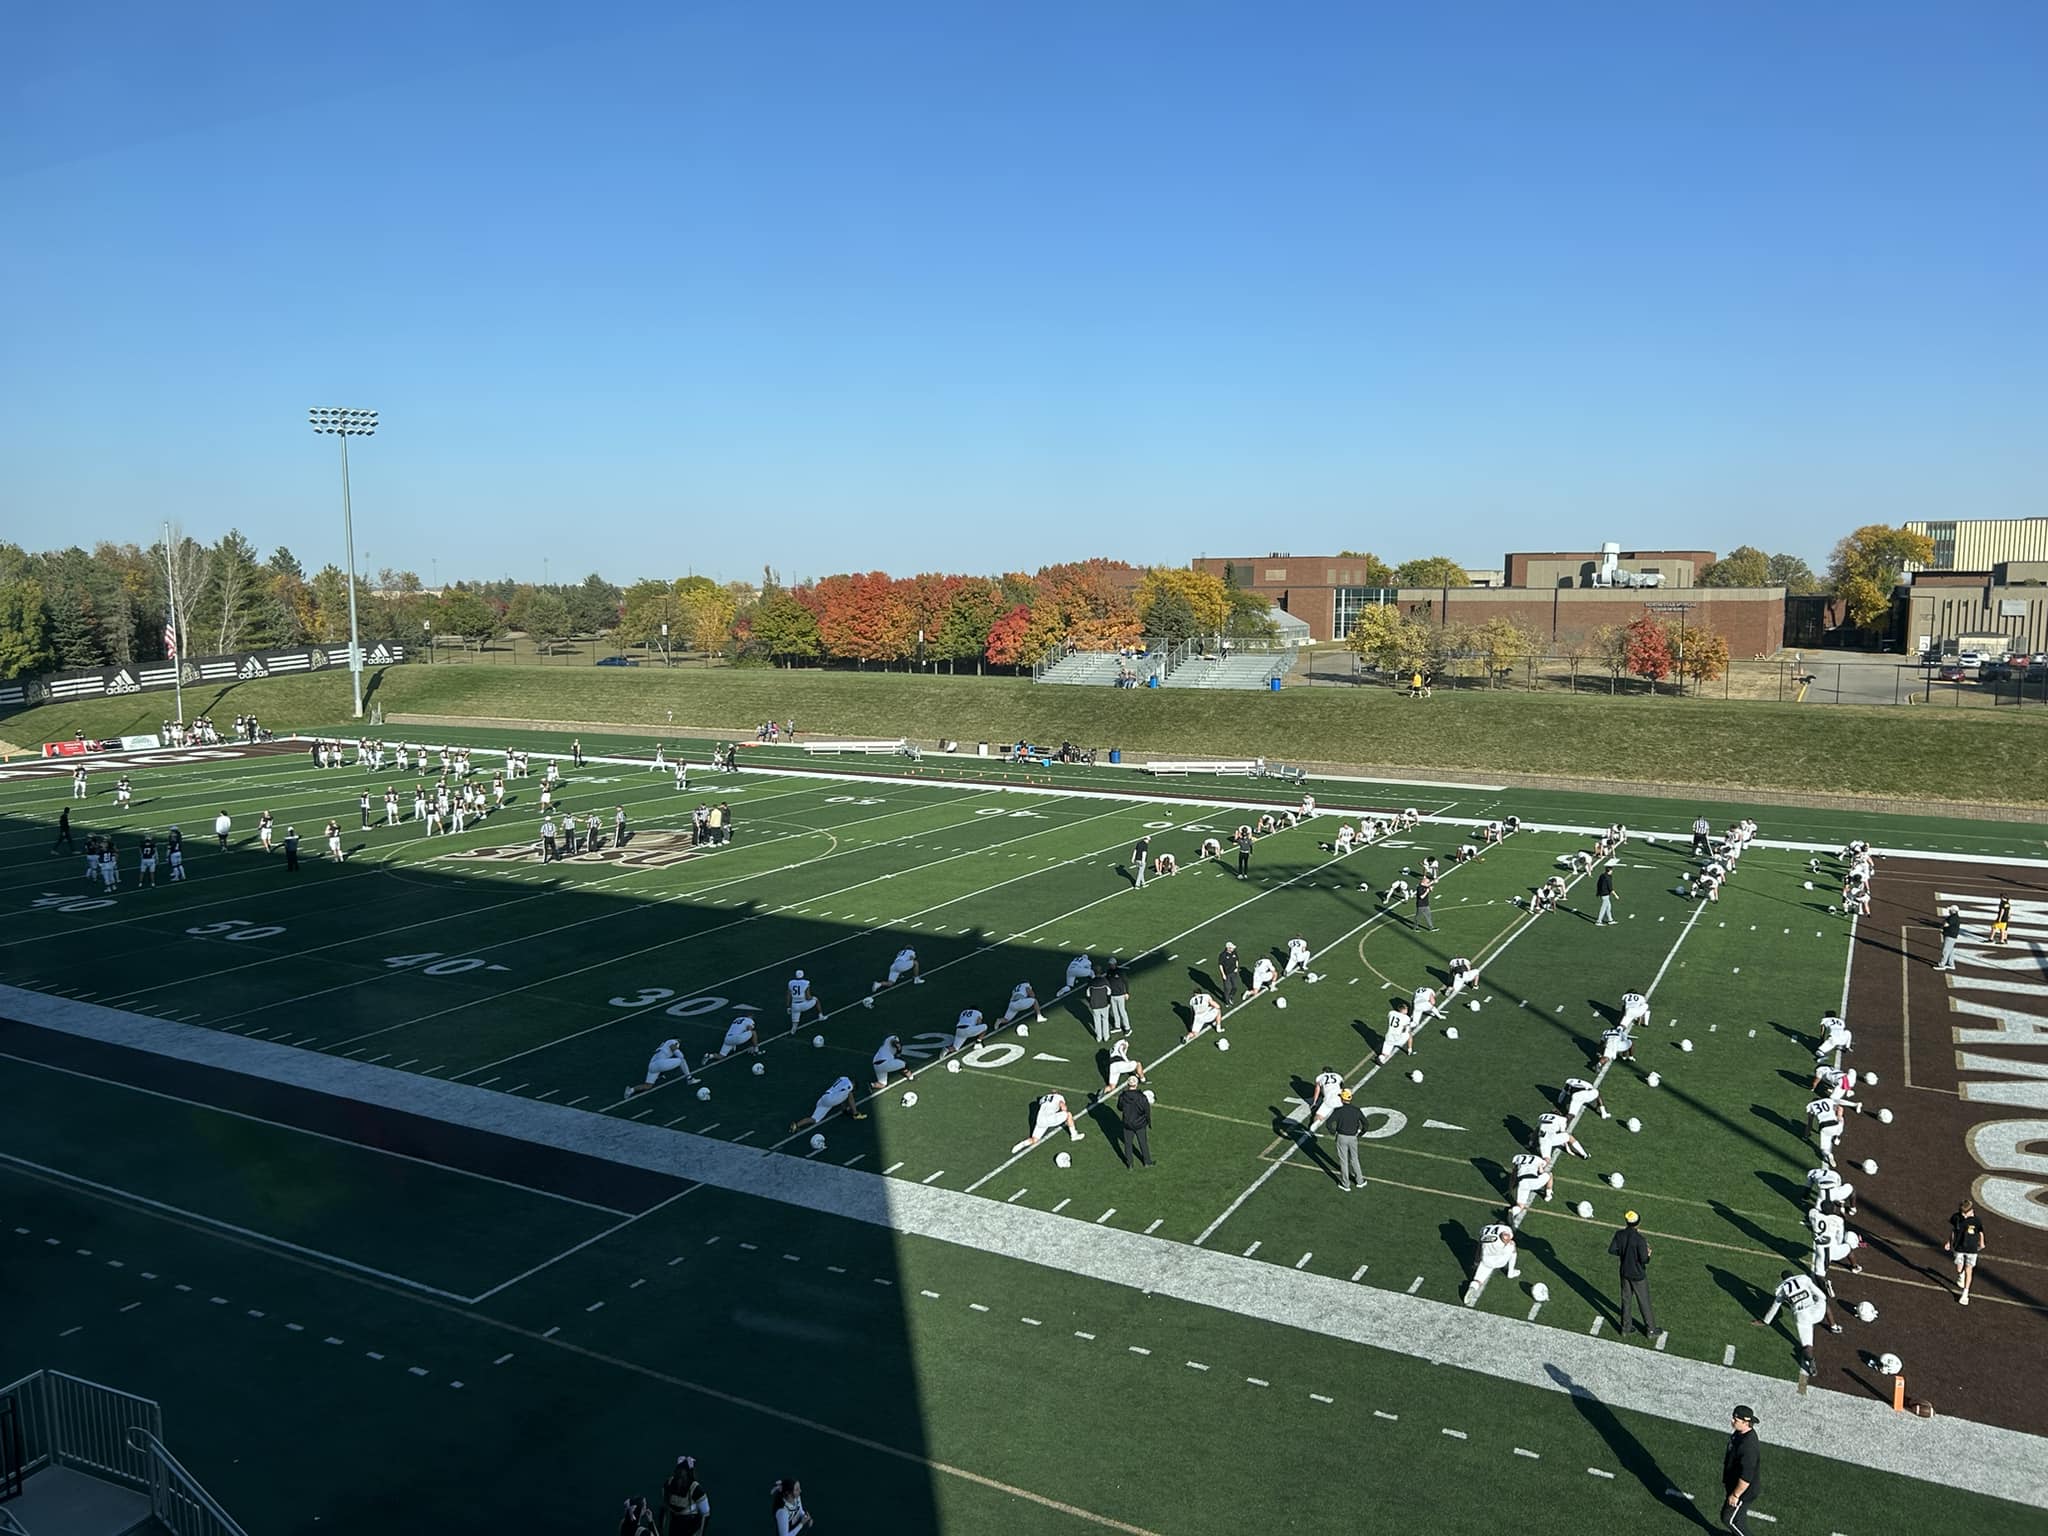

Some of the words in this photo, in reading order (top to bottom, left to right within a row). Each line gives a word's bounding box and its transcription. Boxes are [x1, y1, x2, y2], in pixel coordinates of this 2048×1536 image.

[368, 655, 394, 665] adidas
[238, 669, 269, 680] adidas
[105, 683, 141, 696] adidas
[186, 919, 287, 941] 50
[384, 952, 486, 976] 40
[792, 985, 802, 996] 51
[609, 988, 729, 1017] 30
[1390, 1015, 1401, 1029] 13
[900, 1032, 1026, 1069] 20
[1323, 1074, 1338, 1085] 25
[1813, 1100, 1831, 1114] 30
[1520, 1155, 1536, 1165] 27
[1484, 1226, 1500, 1236] 74
[1817, 1220, 1827, 1235] 9
[1783, 1279, 1801, 1294] 71
